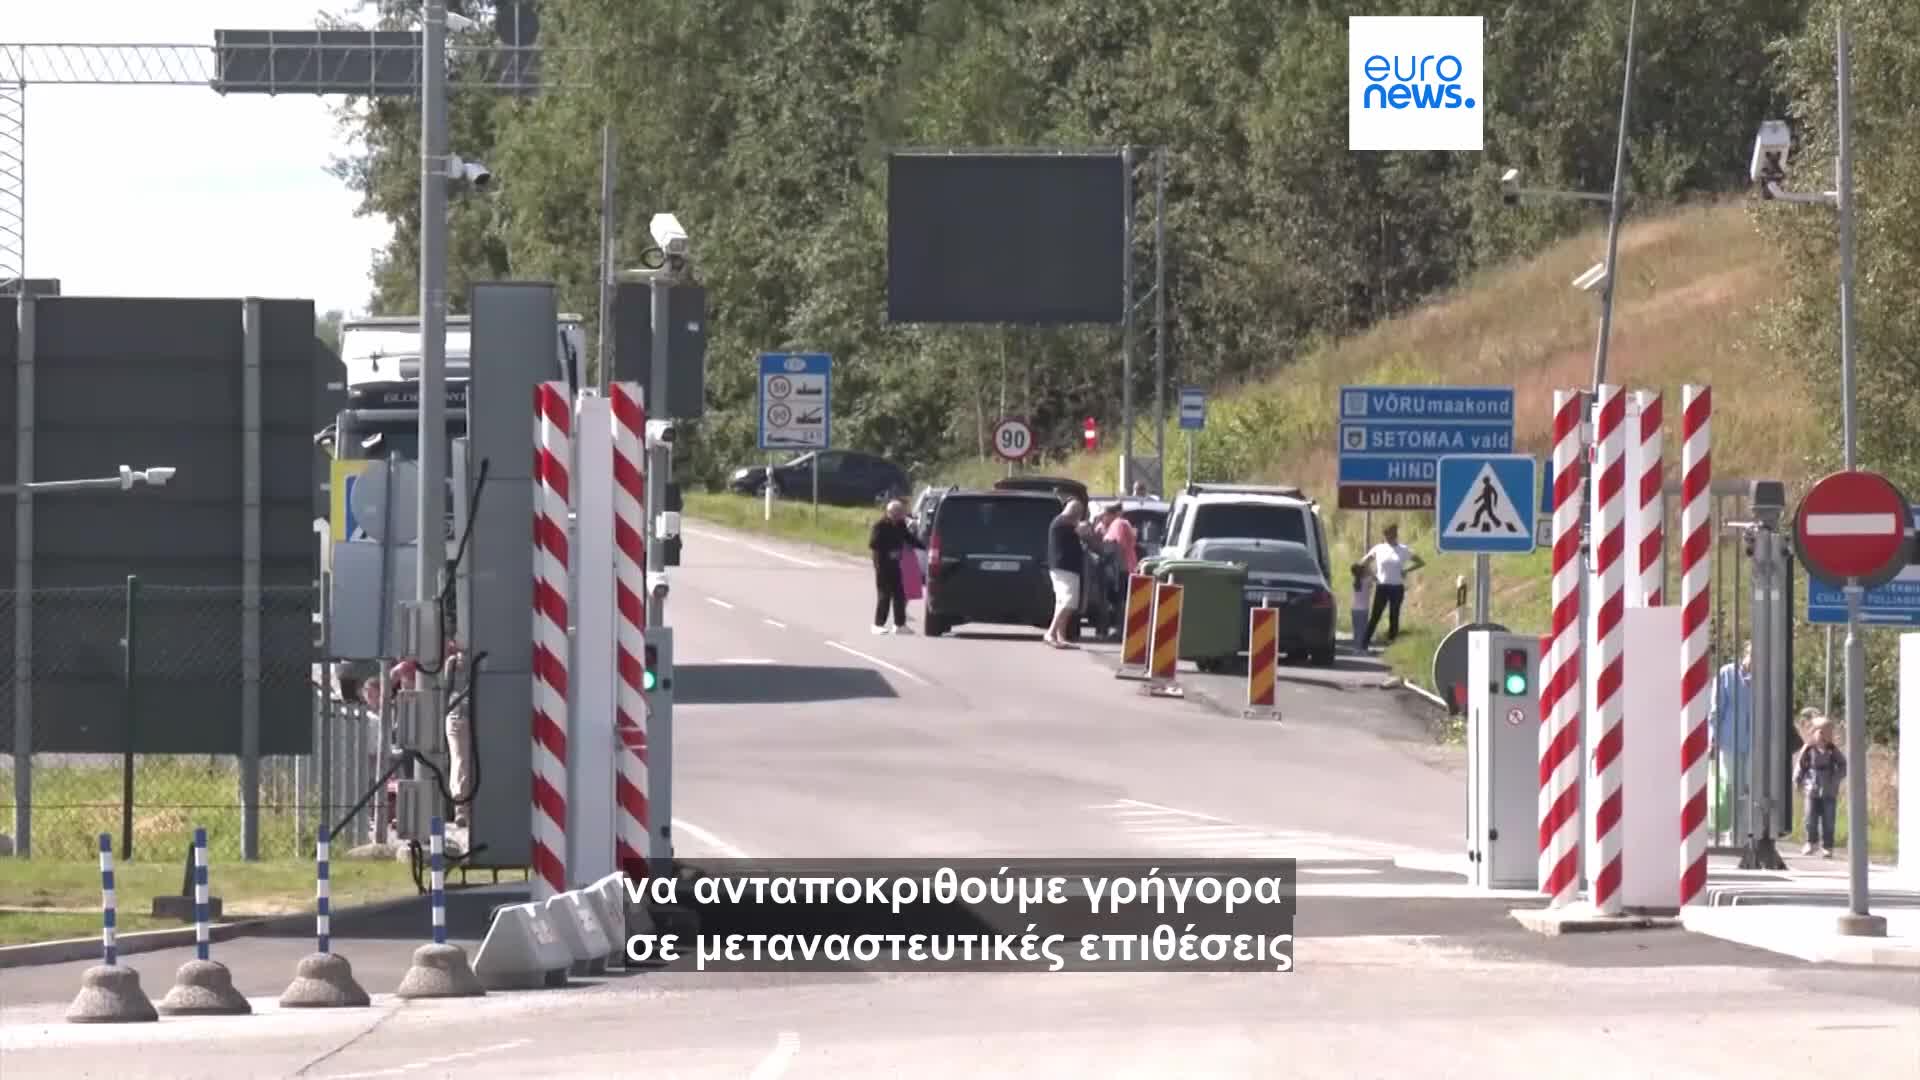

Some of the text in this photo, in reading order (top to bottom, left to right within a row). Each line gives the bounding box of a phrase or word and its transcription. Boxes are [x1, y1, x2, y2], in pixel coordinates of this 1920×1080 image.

[1002, 430, 1025, 449] 90
[1372, 431, 1510, 449] SETOMAA vald
[1387, 461, 1435, 480] HIND
[1358, 489, 1436, 506] Luhama
